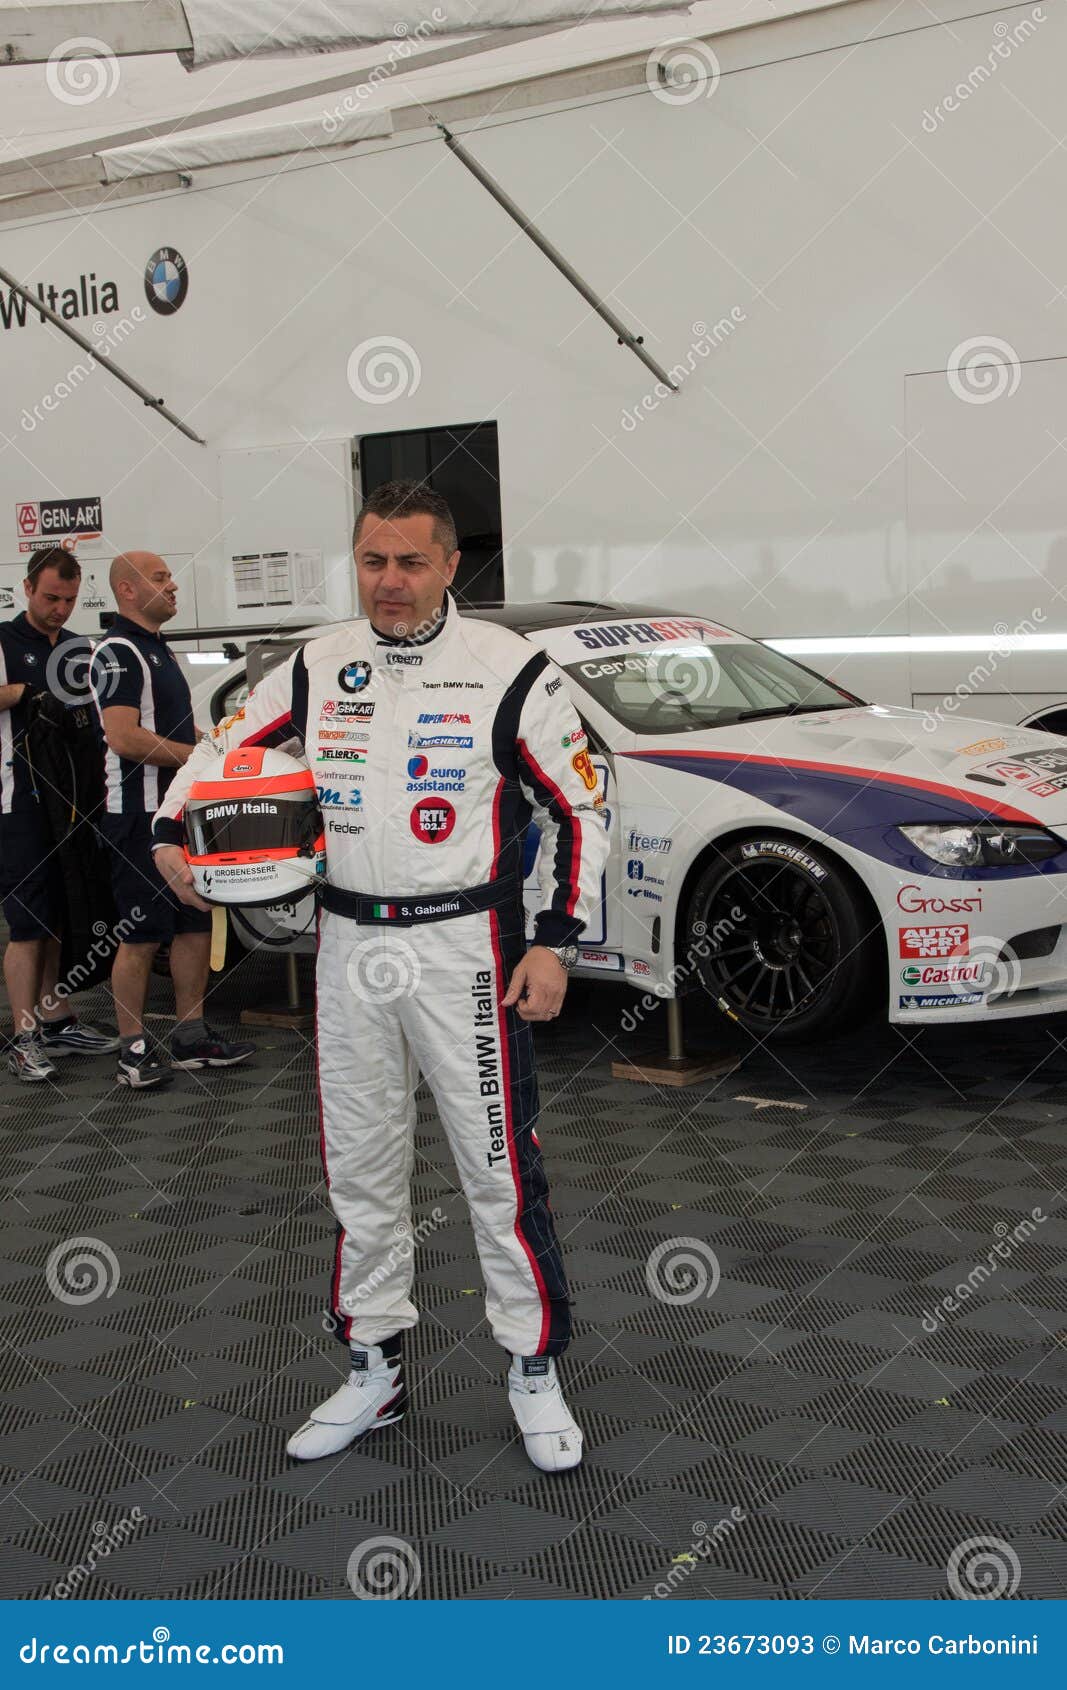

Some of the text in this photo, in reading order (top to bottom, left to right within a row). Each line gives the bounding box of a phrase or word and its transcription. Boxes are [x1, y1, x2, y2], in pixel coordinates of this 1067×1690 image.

[41, 505, 100, 529] GEN-ART
[422, 681, 441, 689] Team
[443, 681, 463, 689] BMW
[421, 737, 471, 746] MICHELIN
[431, 768, 466, 780] europ
[406, 780, 465, 792] assistance
[205, 803, 277, 821] BMW Italia
[420, 809, 447, 822] RTL
[420, 822, 447, 831] 102.5
[629, 831, 673, 852] freem
[760, 843, 826, 879] MICHELIN
[214, 864, 276, 877] IDROBENESSERE
[897, 885, 983, 913] Grossi
[401, 901, 460, 917] S. Gabellini
[903, 926, 967, 940] AUTO
[906, 936, 962, 949] SPRI
[919, 947, 949, 957] NT
[922, 964, 979, 984] Castrol
[921, 994, 983, 1007] MICHELIN
[472, 970, 507, 1168] Team BMW Italia
